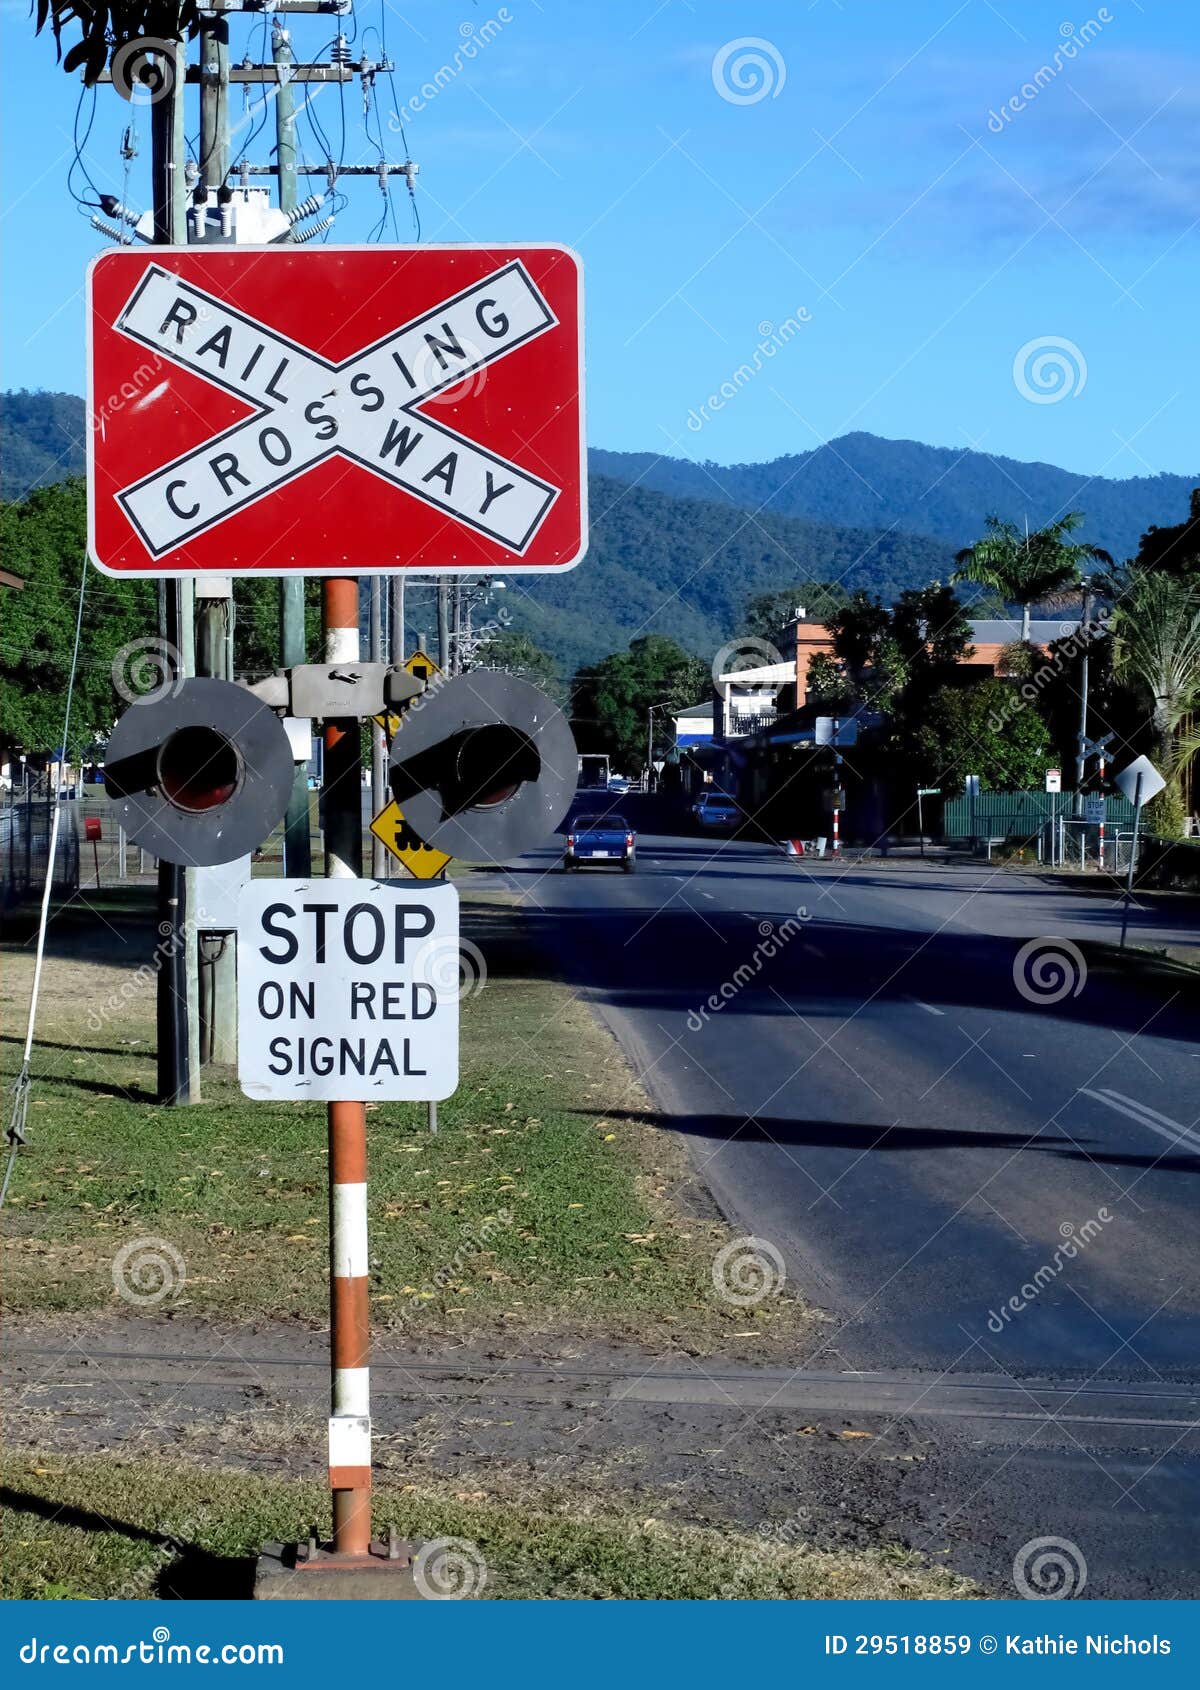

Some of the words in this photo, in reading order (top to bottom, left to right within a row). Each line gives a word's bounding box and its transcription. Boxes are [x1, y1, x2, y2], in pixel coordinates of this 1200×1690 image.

[259, 902, 436, 965] STOP
[258, 981, 315, 1020] ON
[351, 981, 437, 1020] RED
[268, 1037, 427, 1076] SIGNAL
